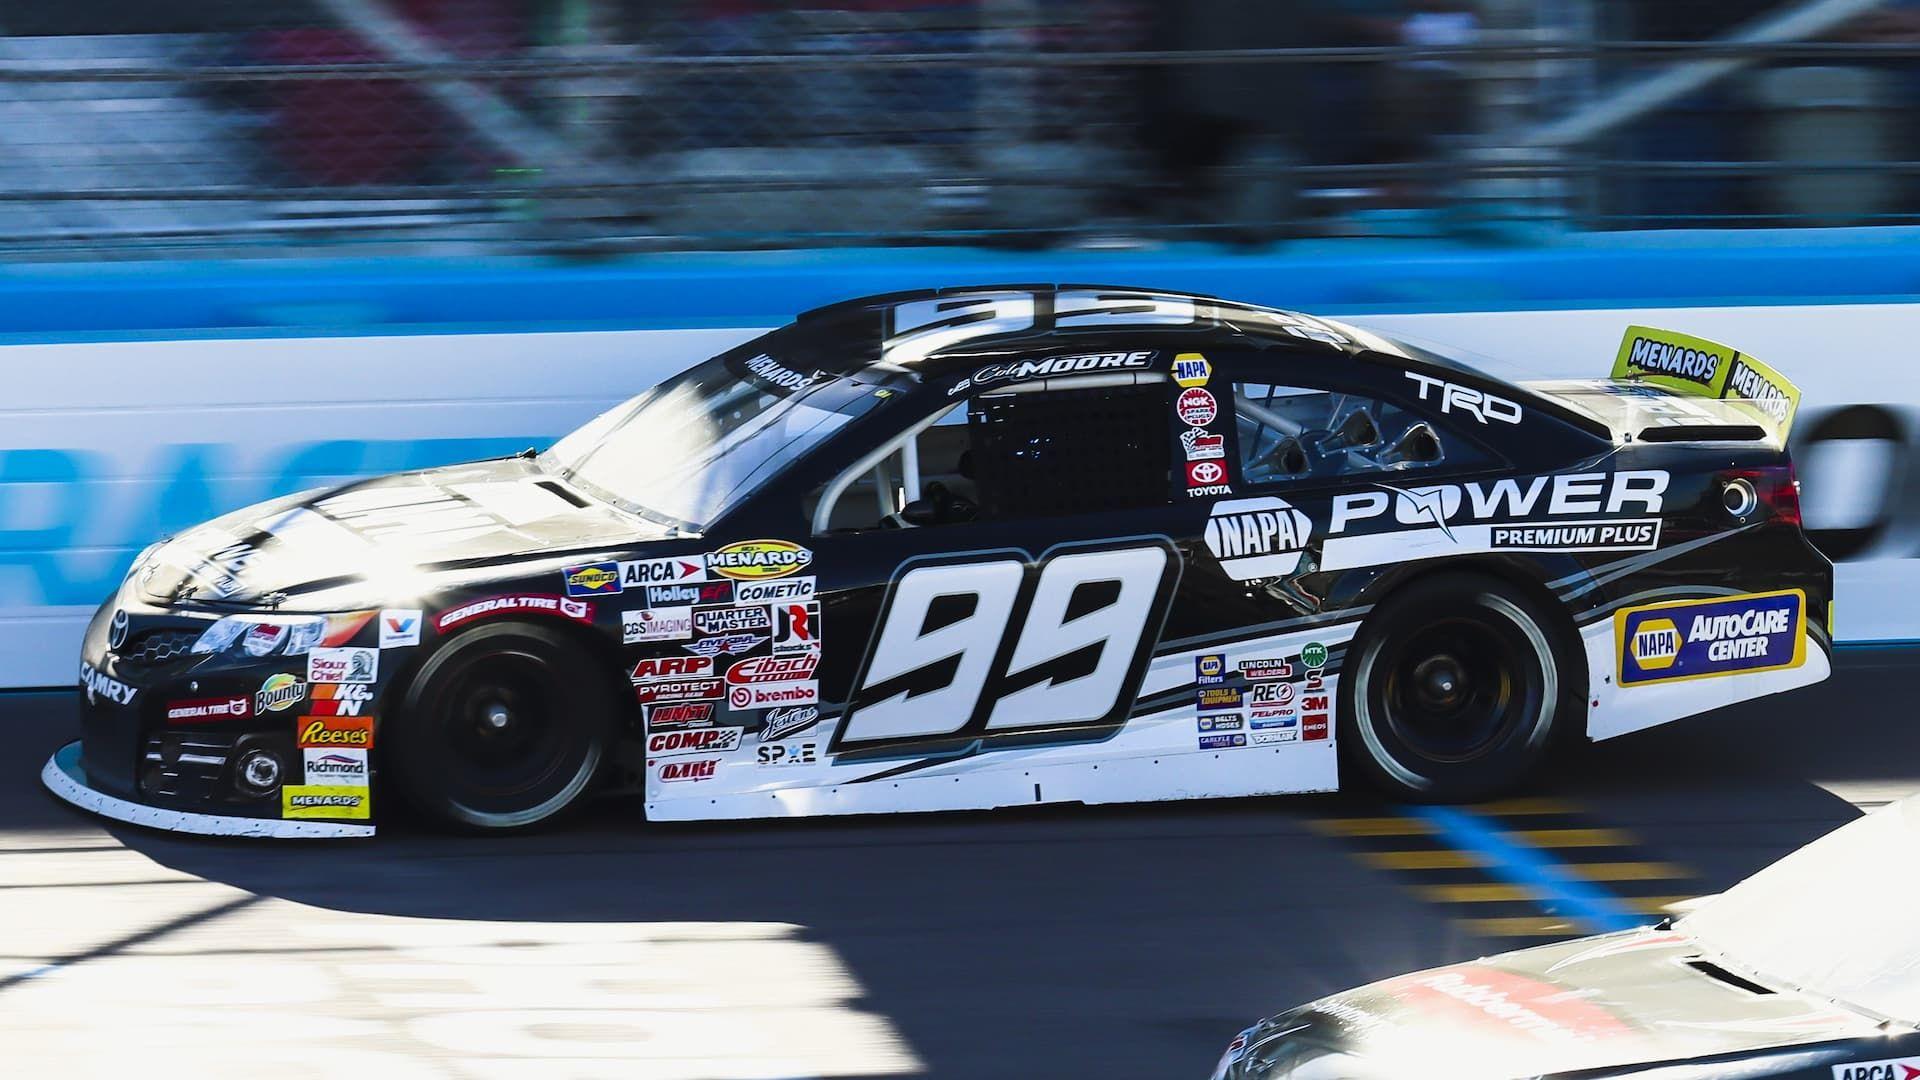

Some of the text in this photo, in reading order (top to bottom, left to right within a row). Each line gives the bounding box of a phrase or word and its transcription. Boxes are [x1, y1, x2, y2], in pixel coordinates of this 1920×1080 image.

[1017, 351, 1152, 378] MOORE
[1177, 361, 1208, 379] NAPA
[1630, 339, 1718, 380] MENARDS
[744, 353, 815, 391] MENARDS
[1184, 396, 1210, 407] NGK
[1405, 371, 1523, 425] TRD
[1731, 362, 1791, 421] MENARDS
[1187, 484, 1233, 498] TOYOTA
[1328, 470, 1670, 534] POWER
[1218, 508, 1300, 556] NAPA
[1495, 525, 1653, 546] PREMIUM PLUS
[706, 551, 811, 567] MENARDS
[568, 571, 618, 584] SUNOCO
[624, 561, 676, 584] ARCA
[649, 585, 700, 604] Holley
[740, 581, 812, 600] COMETIC
[439, 596, 558, 627] GENERAL TIRE
[696, 608, 764, 626] QUARTER
[707, 618, 768, 633] MASTER
[841, 547, 1168, 743] 99
[1637, 632, 1674, 657] NAPA
[1708, 637, 1769, 662] CENTER
[312, 657, 347, 670] Sioux
[633, 656, 712, 677] ARP
[727, 653, 818, 685] Eibach
[1240, 660, 1282, 669] LINCOLN
[80, 661, 138, 705] CAMRY
[311, 669, 343, 681] Chief
[639, 680, 721, 696] PYROTECT
[755, 686, 815, 703] brembo
[255, 681, 307, 717] Bounty
[1301, 696, 1329, 711] 3M
[301, 721, 369, 744] Reese's
[649, 730, 720, 752] COMP
[306, 759, 364, 774] Richmond
[291, 795, 361, 806] MENARDS
